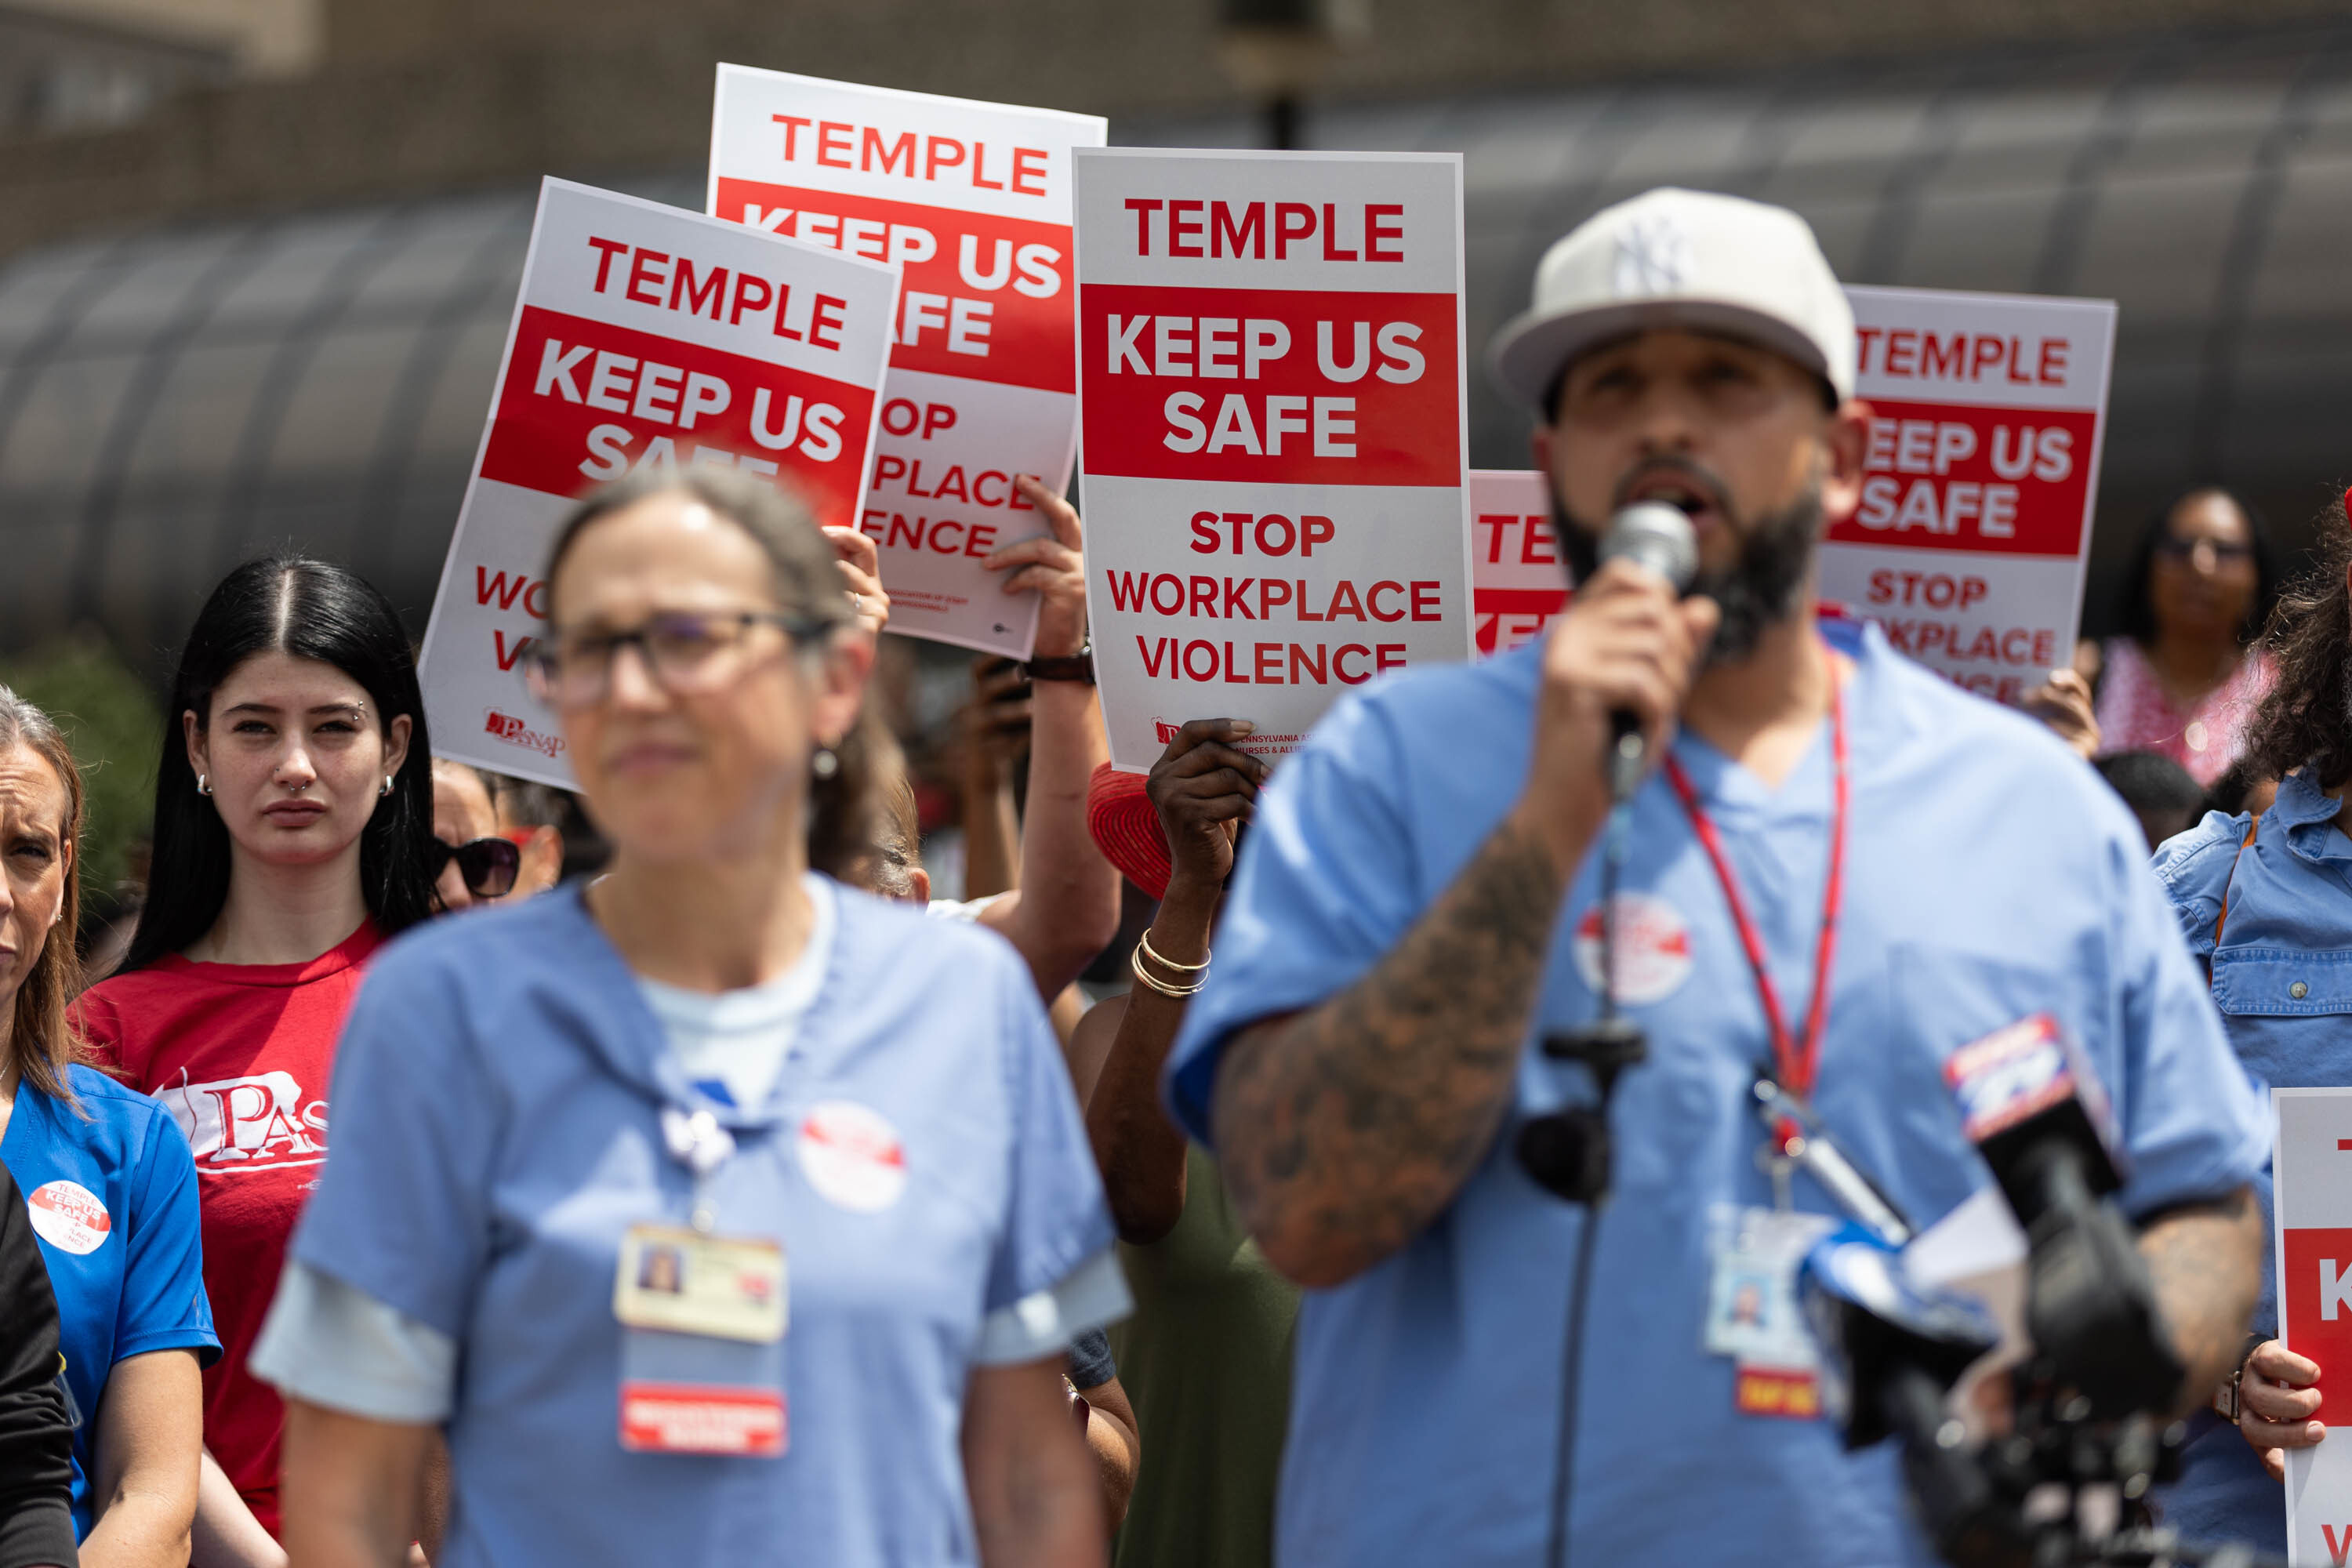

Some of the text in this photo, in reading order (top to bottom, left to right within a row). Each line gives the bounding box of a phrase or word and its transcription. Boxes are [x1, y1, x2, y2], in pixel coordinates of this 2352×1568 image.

[772, 114, 1050, 197] TEMPLE
[1125, 198, 1404, 262] TEMPLE
[588, 236, 848, 353] TEMPLE
[958, 234, 1062, 299] US
[892, 291, 994, 358] FE
[1108, 314, 1426, 384] KEEP US
[1856, 326, 2070, 387] TEMPLE
[533, 338, 847, 463] KEEP US
[880, 398, 958, 441] OP
[1163, 391, 1357, 458] SAFE
[1864, 416, 2074, 484] EEP US
[872, 454, 1041, 511] PLACE
[1853, 476, 2020, 539] SAFE
[861, 509, 998, 559] ENCE
[1189, 511, 1335, 557] STOP
[1107, 569, 1443, 622] WORKPLACE
[1866, 568, 1989, 611] STOP
[1884, 617, 2056, 668] KPLACE
[1238, 734, 1299, 743] ENNSYLVANIA
[45, 1190, 101, 1221] KEEP US
[54, 1204, 89, 1225] SAFE
